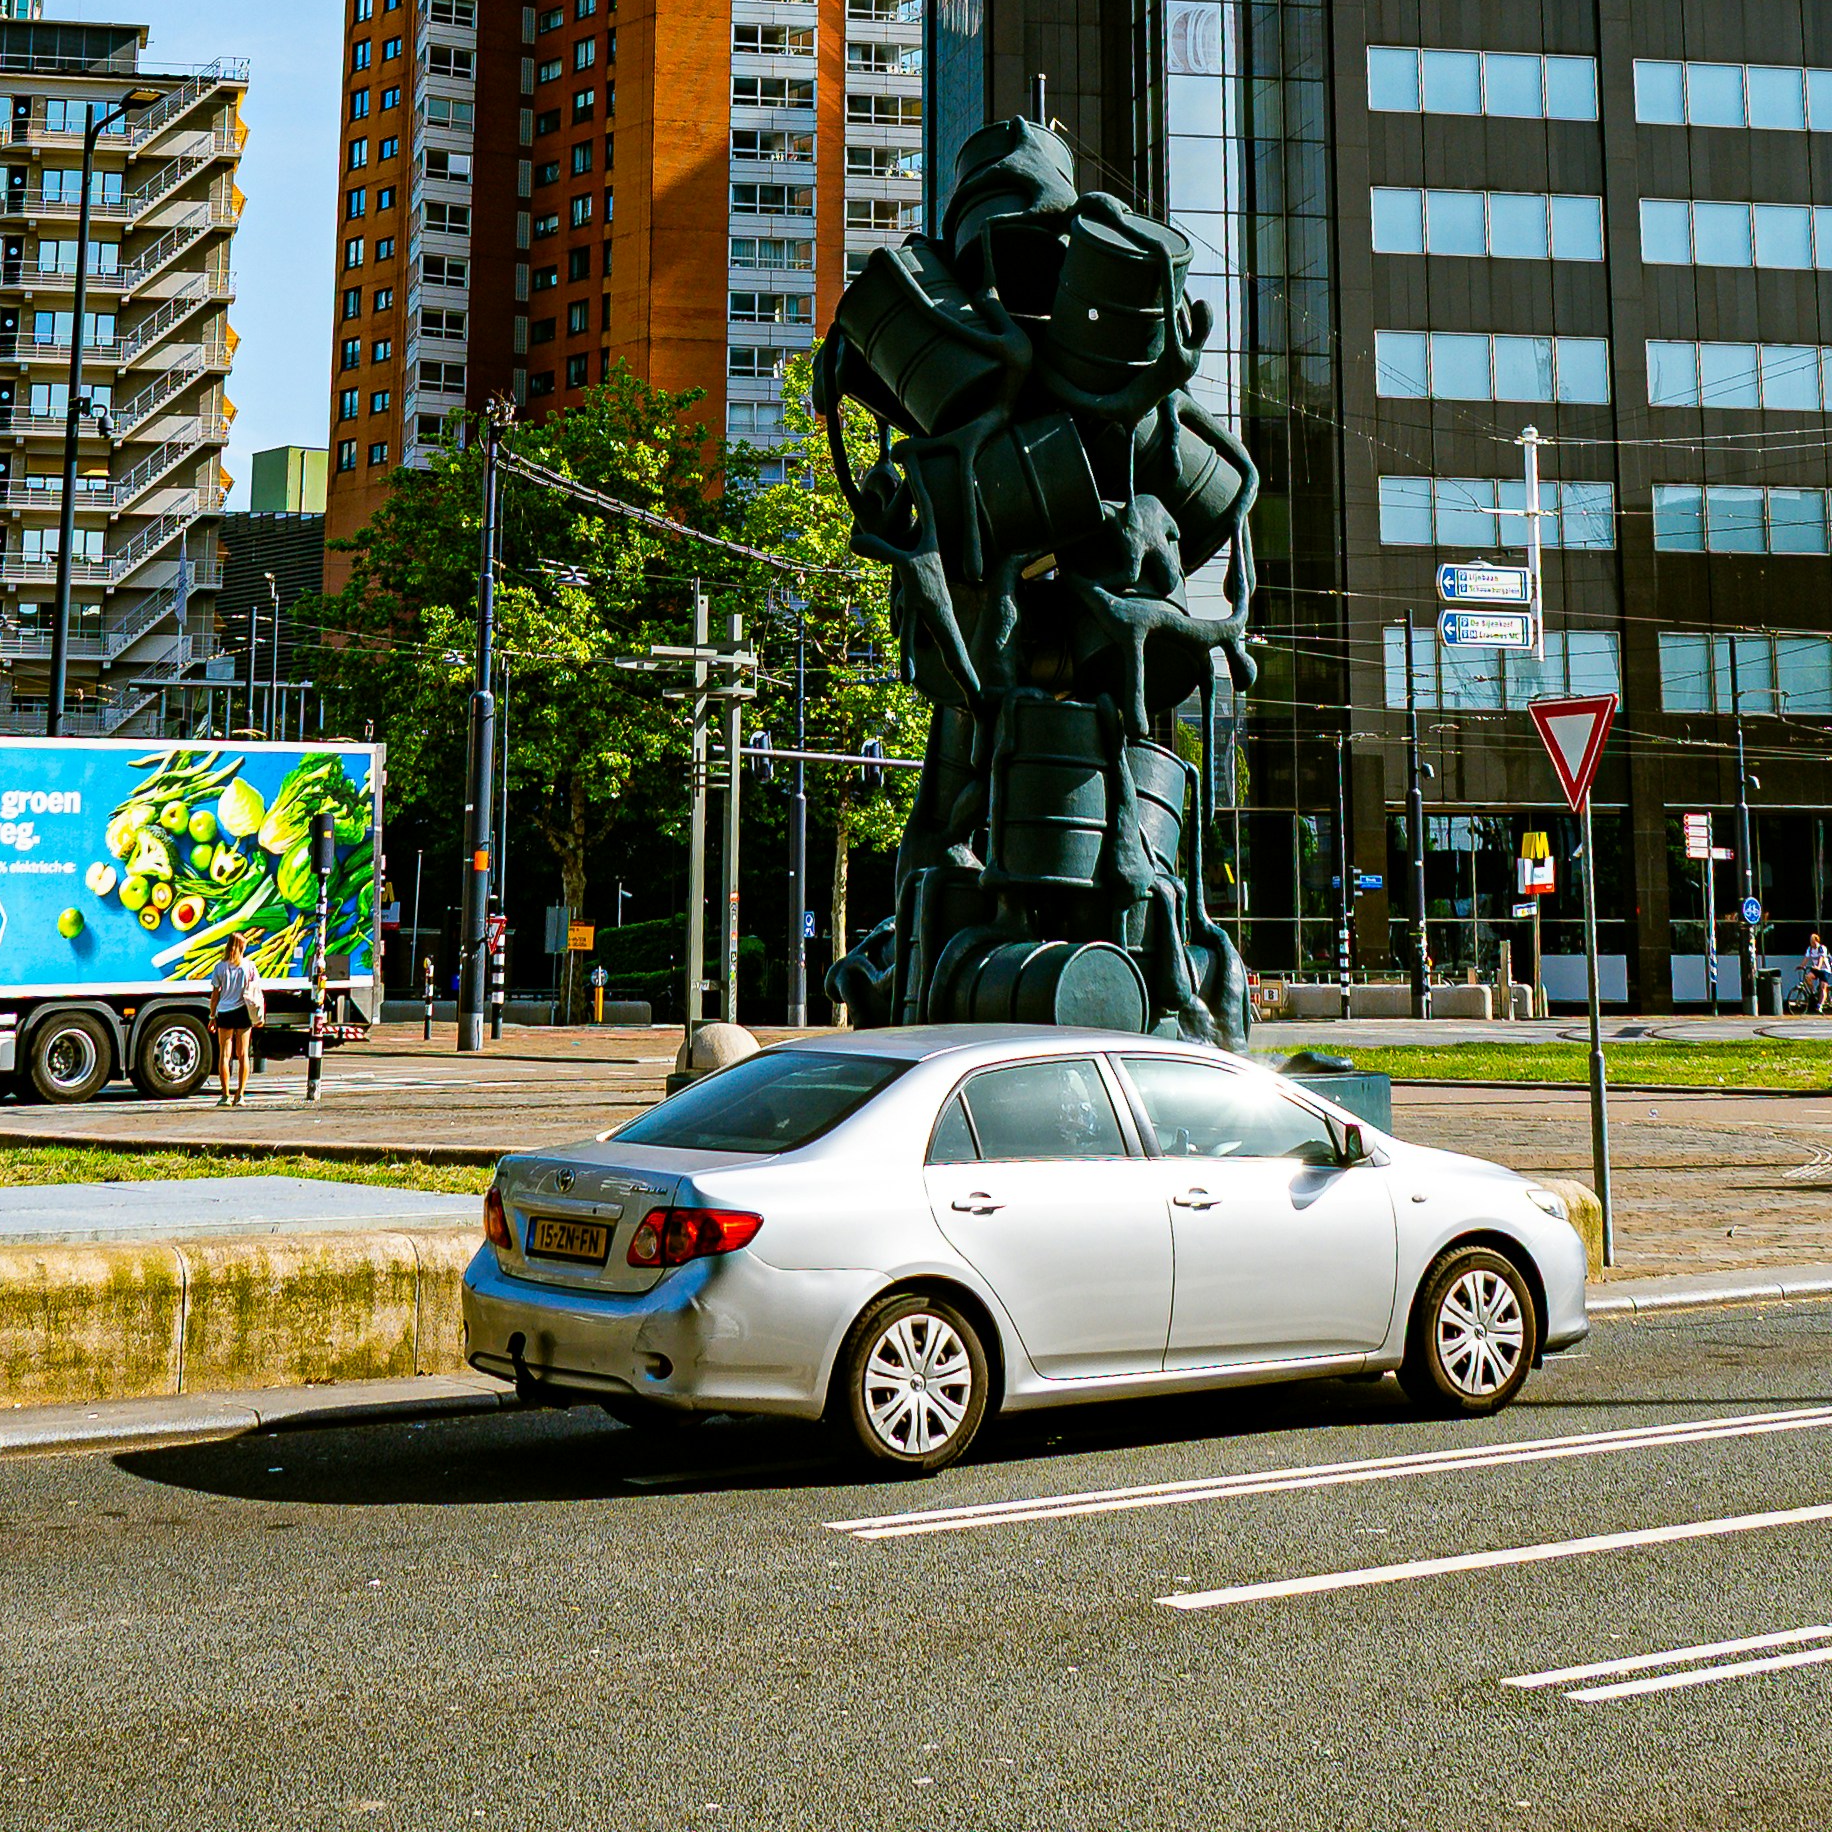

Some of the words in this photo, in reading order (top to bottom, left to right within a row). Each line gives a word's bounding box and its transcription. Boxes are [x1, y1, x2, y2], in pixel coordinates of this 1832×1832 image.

[0, 790, 82, 820] groen
[9, 860, 62, 874] elektrisch
[540, 1223, 600, 1254] 15-ZN-FN
